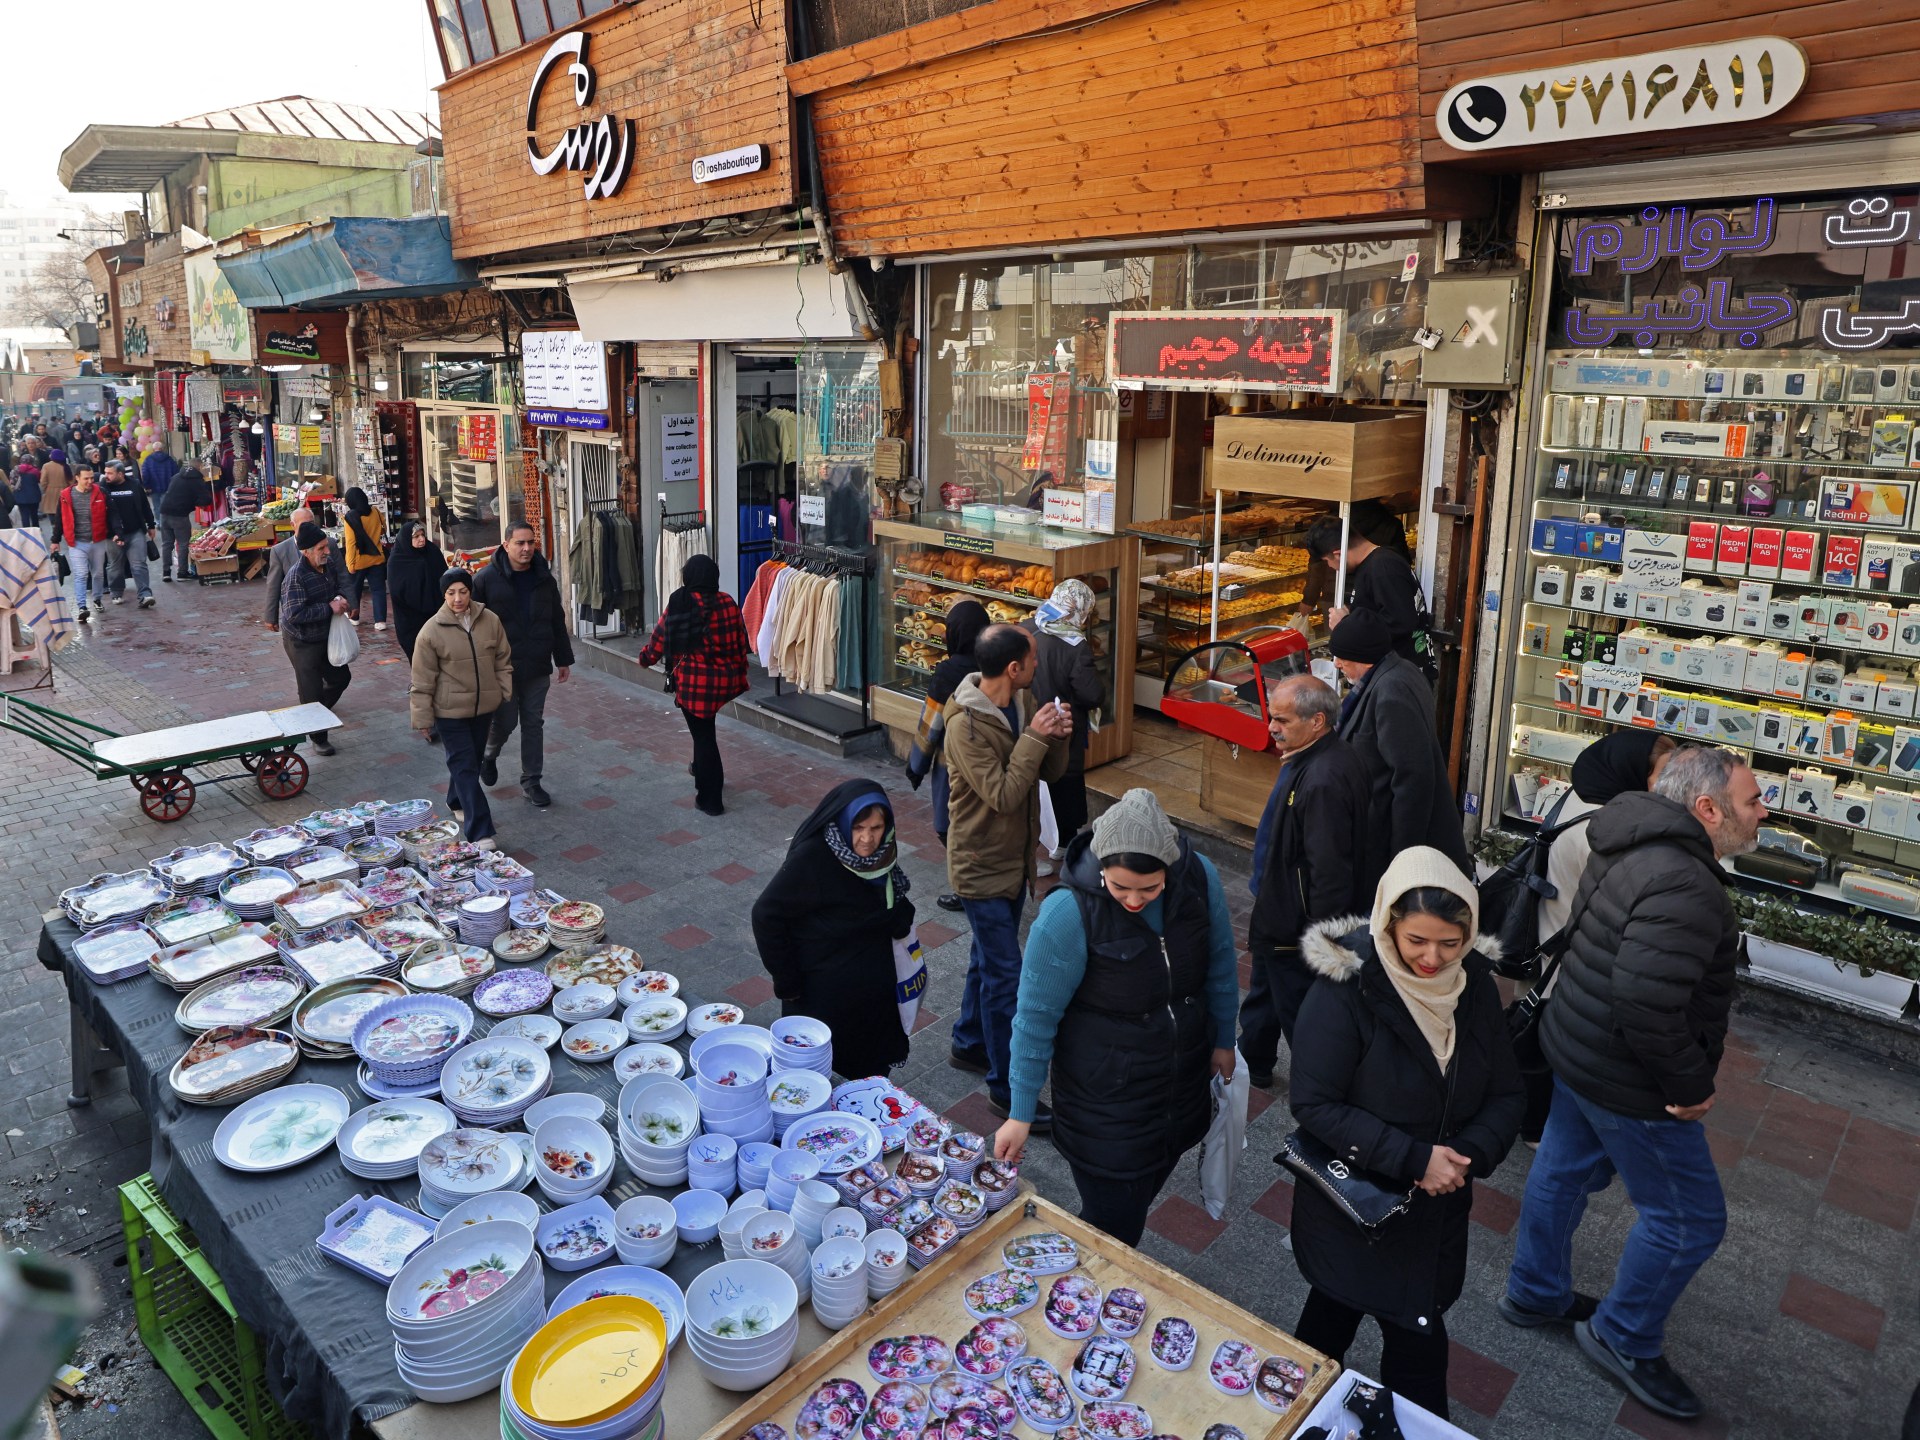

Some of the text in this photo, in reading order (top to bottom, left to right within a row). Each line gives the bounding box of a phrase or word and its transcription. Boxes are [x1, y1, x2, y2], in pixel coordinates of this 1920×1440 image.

[1518, 49, 1775, 133] ۲۲۷۱۶۸۱۱
[705, 153, 760, 175] roshaboutique
[1572, 196, 1776, 275] لوازم
[1564, 280, 1796, 348] جانبی
[1159, 336, 1239, 373] حجیم
[667, 417, 695, 428] طبقه اول
[1226, 440, 1336, 474] Delimanjo
[1047, 496, 1071, 508] فروشنده
[1069, 514, 1083, 524] خانم
[1824, 509, 1857, 520] Redmi
[1859, 512, 1882, 521] Pad
[1689, 536, 1714, 544] REDMI
[1786, 546, 1811, 554] REDMI
[1828, 551, 1857, 566] 14C
[1628, 558, 1659, 576] ویترین
